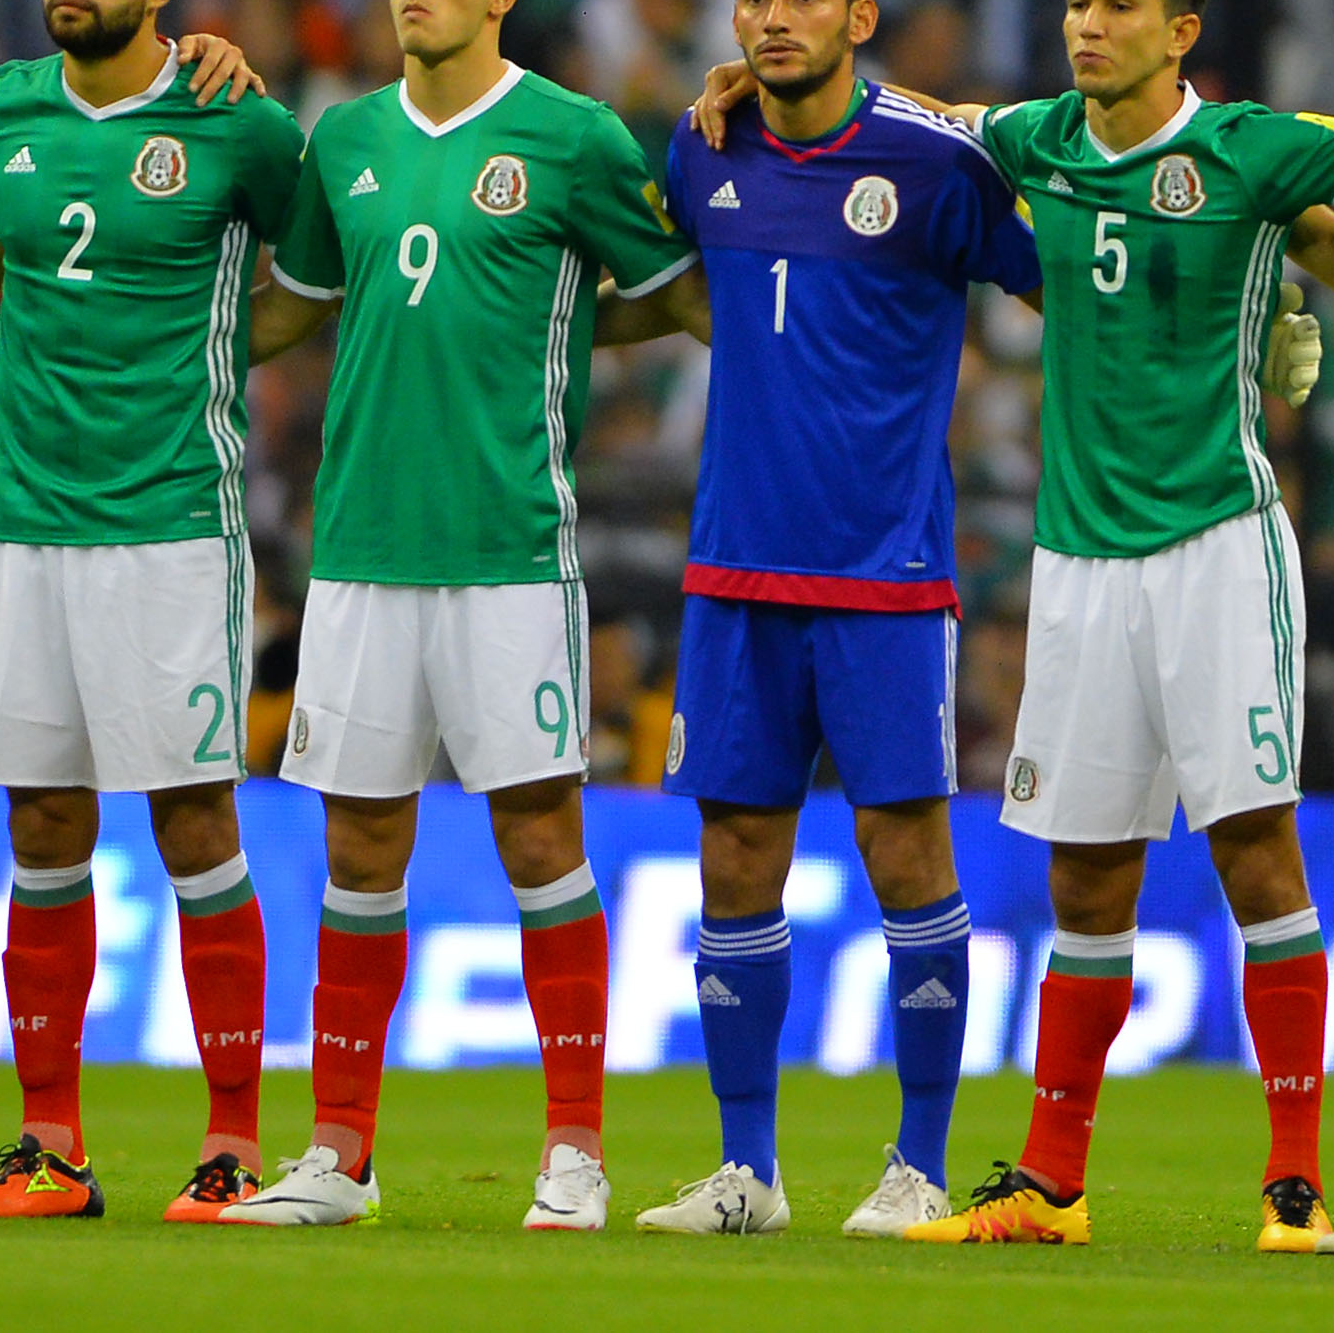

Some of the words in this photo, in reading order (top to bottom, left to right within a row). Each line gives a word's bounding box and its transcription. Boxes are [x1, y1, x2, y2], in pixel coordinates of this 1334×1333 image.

[57, 202, 96, 282] 2
[397, 224, 439, 307] 9
[1091, 211, 1128, 294] 5
[769, 258, 788, 334] 1
[186, 681, 230, 765] 2
[533, 680, 571, 759] 9
[1247, 706, 1288, 786] 5
